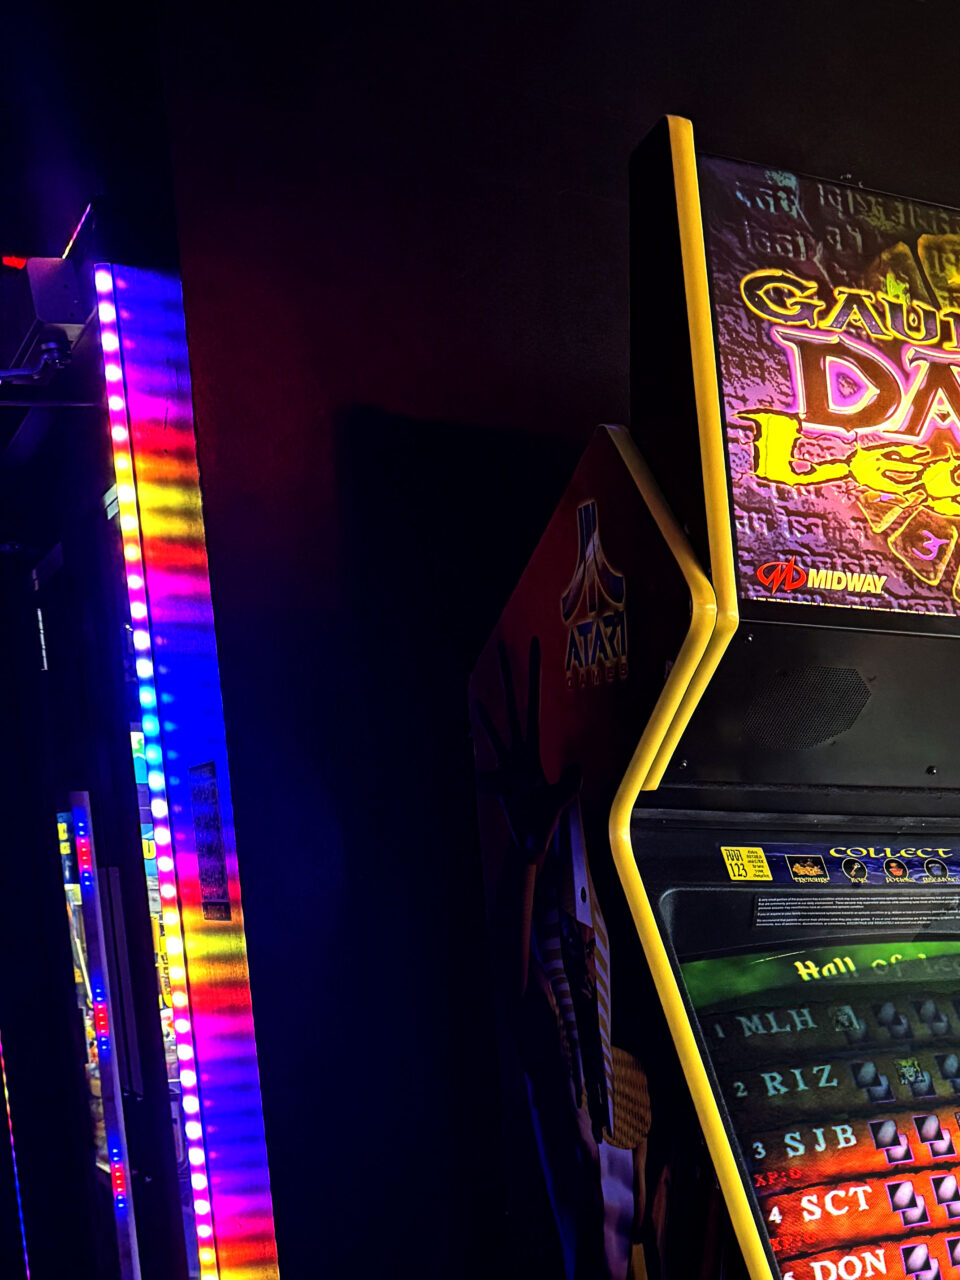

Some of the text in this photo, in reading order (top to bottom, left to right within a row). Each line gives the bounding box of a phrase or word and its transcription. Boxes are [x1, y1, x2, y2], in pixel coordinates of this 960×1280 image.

[806, 568, 888, 594] MIDWAY
[565, 611, 628, 673] ATARI
[829, 846, 953, 859] COLLECT
[729, 862, 748, 878] 123
[793, 956, 858, 982] Hall
[735, 1006, 818, 1038] MLH
[733, 1063, 839, 1098] 2 RIZ
[752, 1123, 858, 1160] 3 SJB
[768, 1185, 873, 1225] 4 SCT
